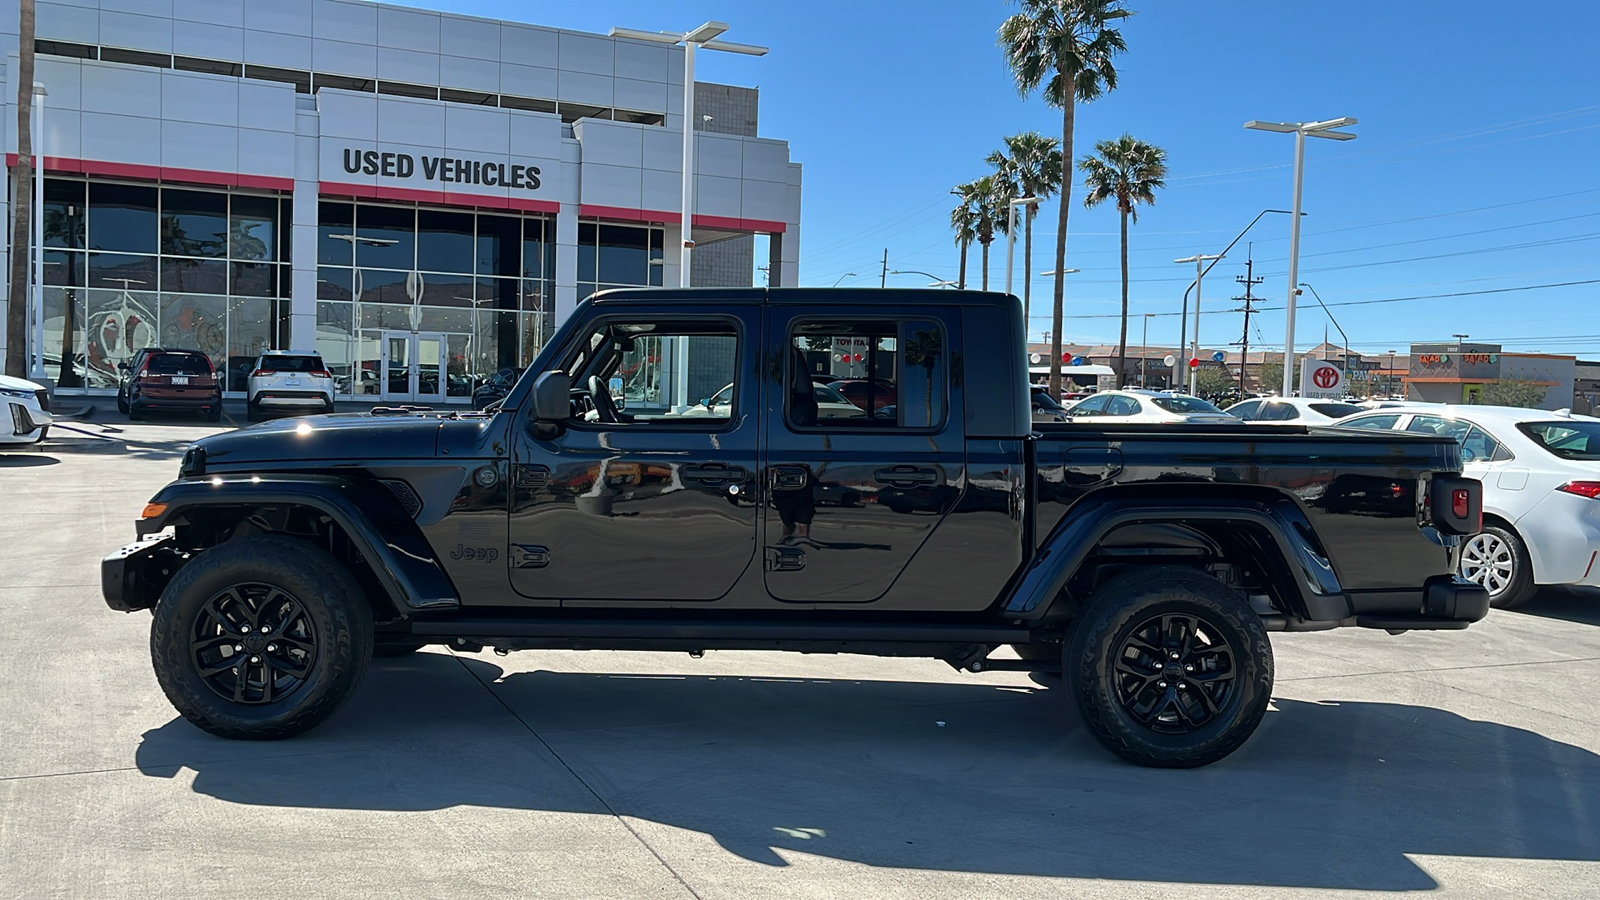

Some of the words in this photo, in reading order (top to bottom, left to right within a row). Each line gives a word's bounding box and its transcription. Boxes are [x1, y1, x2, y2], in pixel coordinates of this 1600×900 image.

[343, 148, 414, 178] USED
[421, 156, 541, 190] VEHICLES
[450, 543, 498, 563] Jeep
